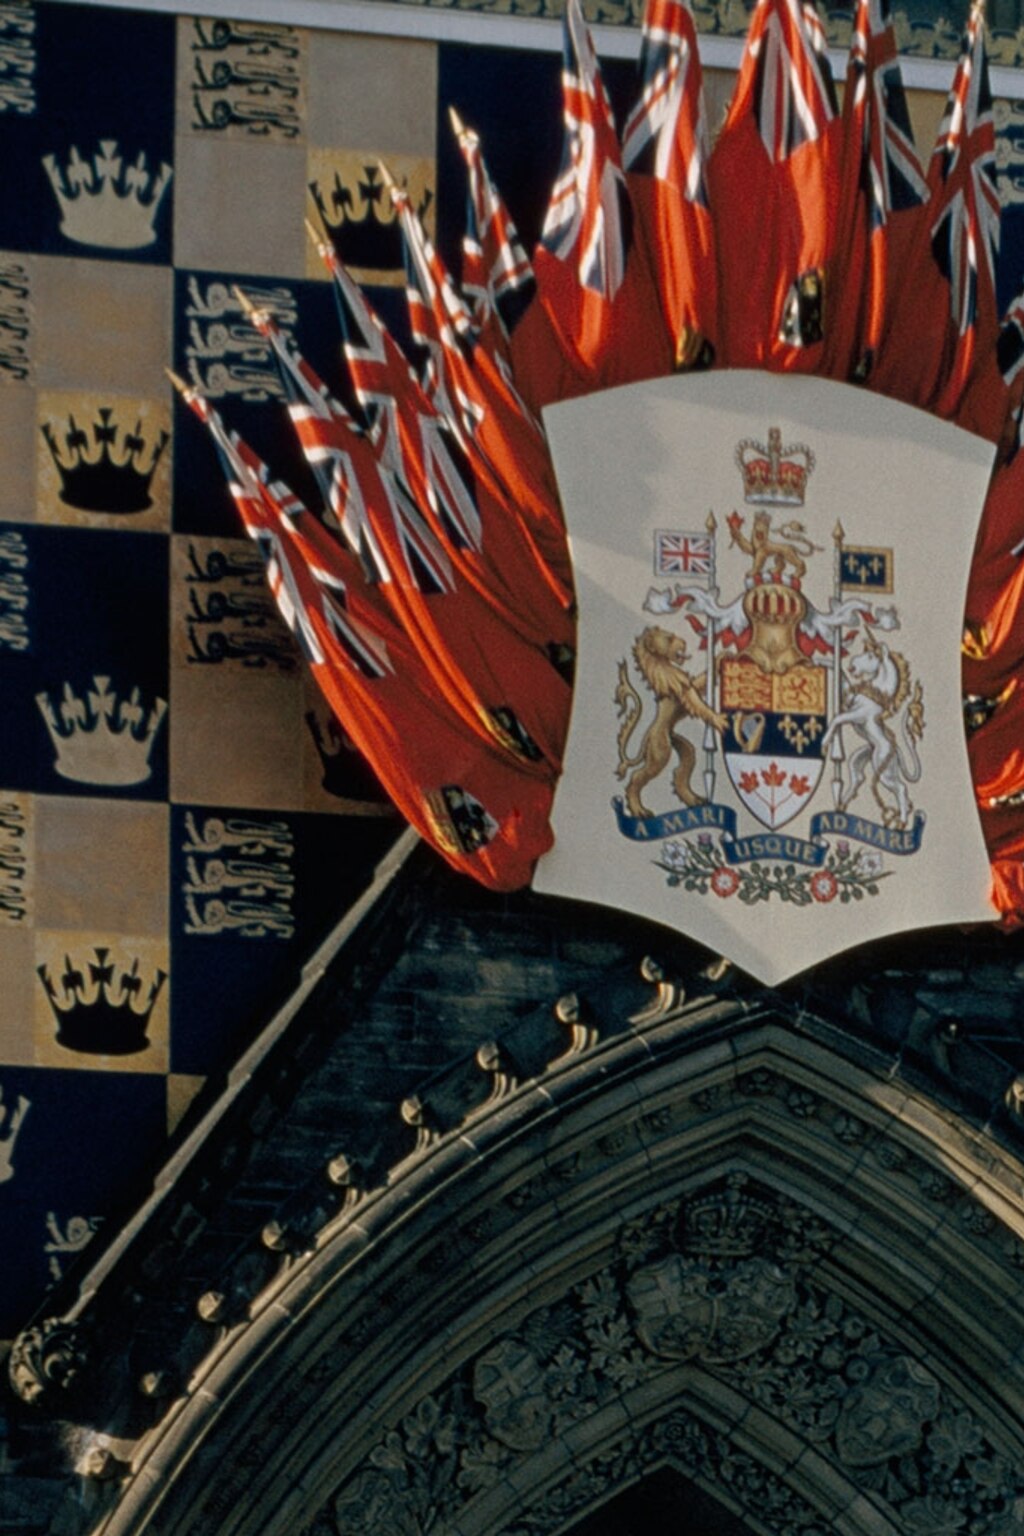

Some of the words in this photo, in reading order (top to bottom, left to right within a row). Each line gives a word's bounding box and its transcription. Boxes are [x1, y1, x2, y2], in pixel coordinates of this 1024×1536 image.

[635, 821, 649, 838] A
[662, 809, 725, 833] MARI
[735, 837, 816, 863] USQUE
[820, 815, 848, 832] AD
[854, 820, 914, 850] MARE
